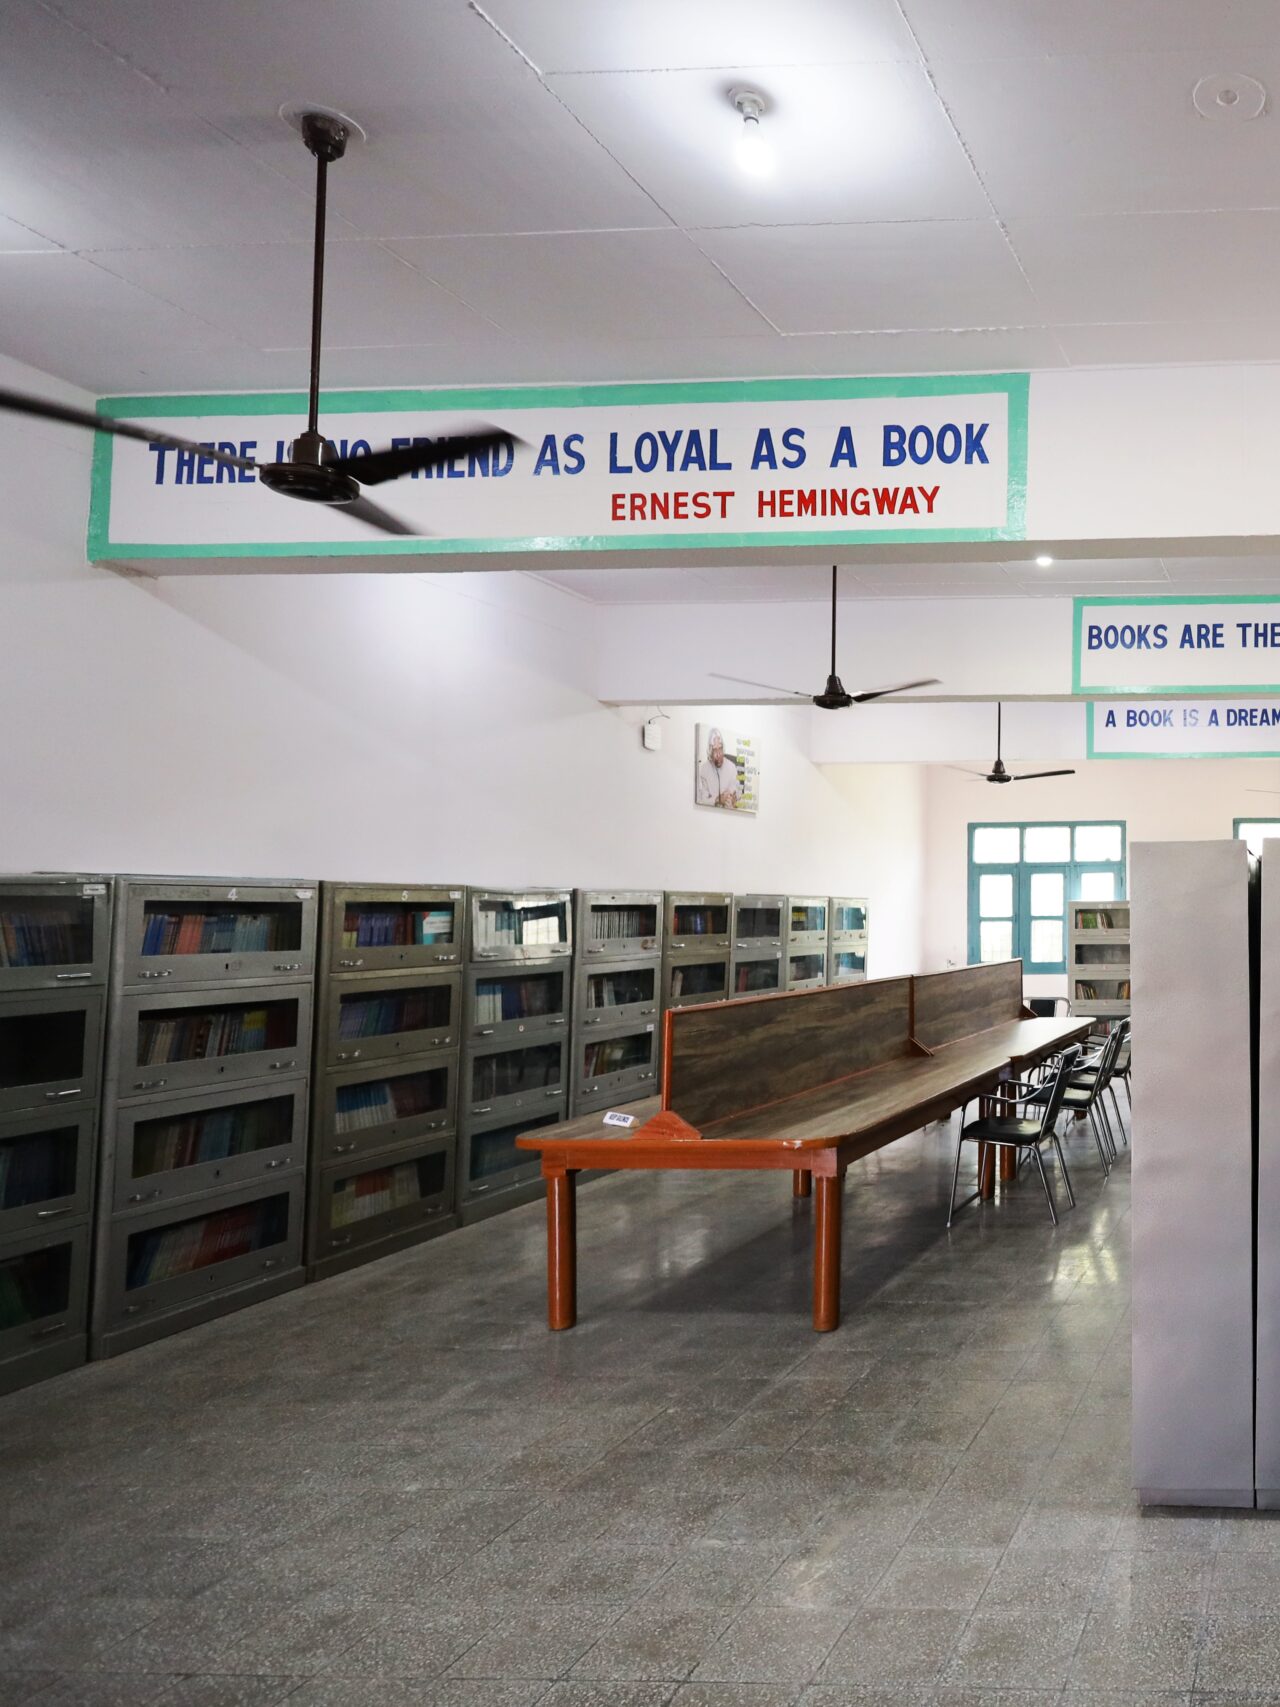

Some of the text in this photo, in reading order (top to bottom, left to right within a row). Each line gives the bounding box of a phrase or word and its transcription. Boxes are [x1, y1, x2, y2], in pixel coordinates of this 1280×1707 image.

[149, 440, 257, 486] THERE
[532, 432, 585, 477] AS
[609, 428, 732, 474] LOYAL
[751, 427, 807, 470] AS
[830, 426, 858, 468] A
[883, 423, 989, 467] BOOK
[611, 485, 940, 521] ERNEST HEMINGWAY
[1087, 624, 1168, 650] BOOKS
[1179, 623, 1225, 649] ARE
[1105, 710, 1117, 728] A
[1126, 709, 1173, 728] BOOK
[1182, 709, 1199, 728] IS
[1208, 708, 1220, 727] A
[227, 888, 238, 900] 4
[401, 890, 409, 901] 5
